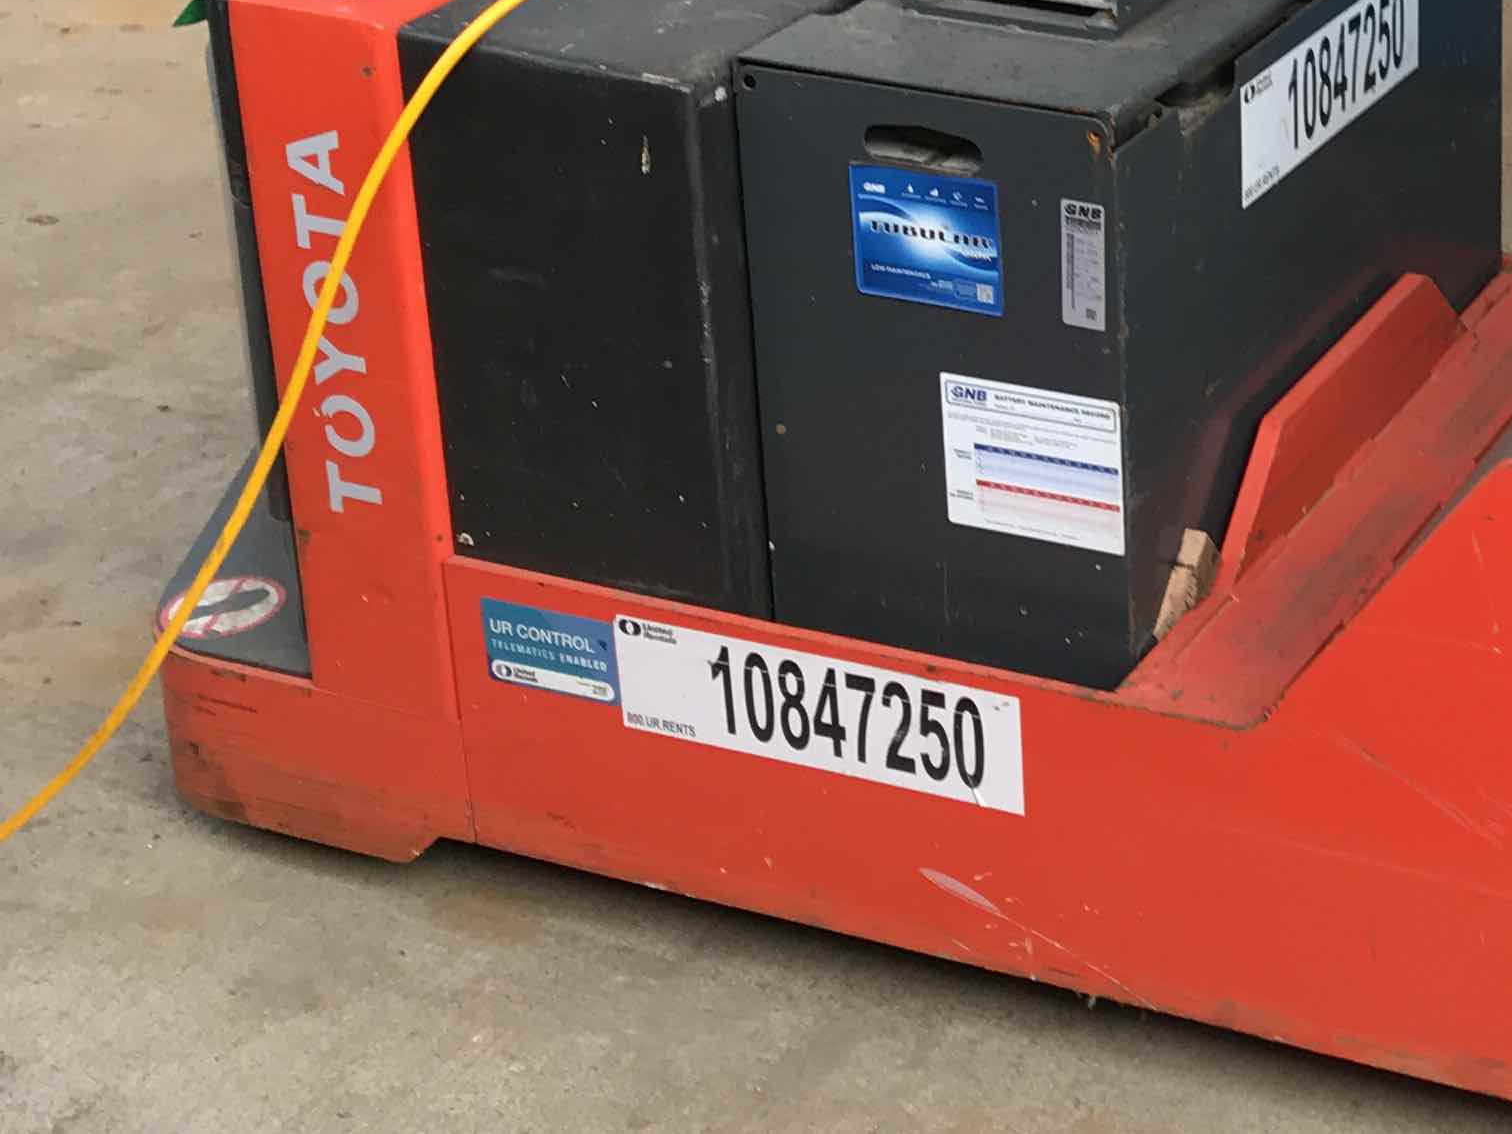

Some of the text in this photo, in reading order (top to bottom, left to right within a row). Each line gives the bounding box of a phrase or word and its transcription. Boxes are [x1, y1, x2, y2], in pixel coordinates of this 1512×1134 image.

[286, 129, 382, 514] TOYOTA
[951, 385, 988, 402] GNB
[489, 617, 596, 654] UR CONTROL
[491, 638, 608, 673] TELEMATICS ENABLED
[711, 645, 985, 790] 10847250
